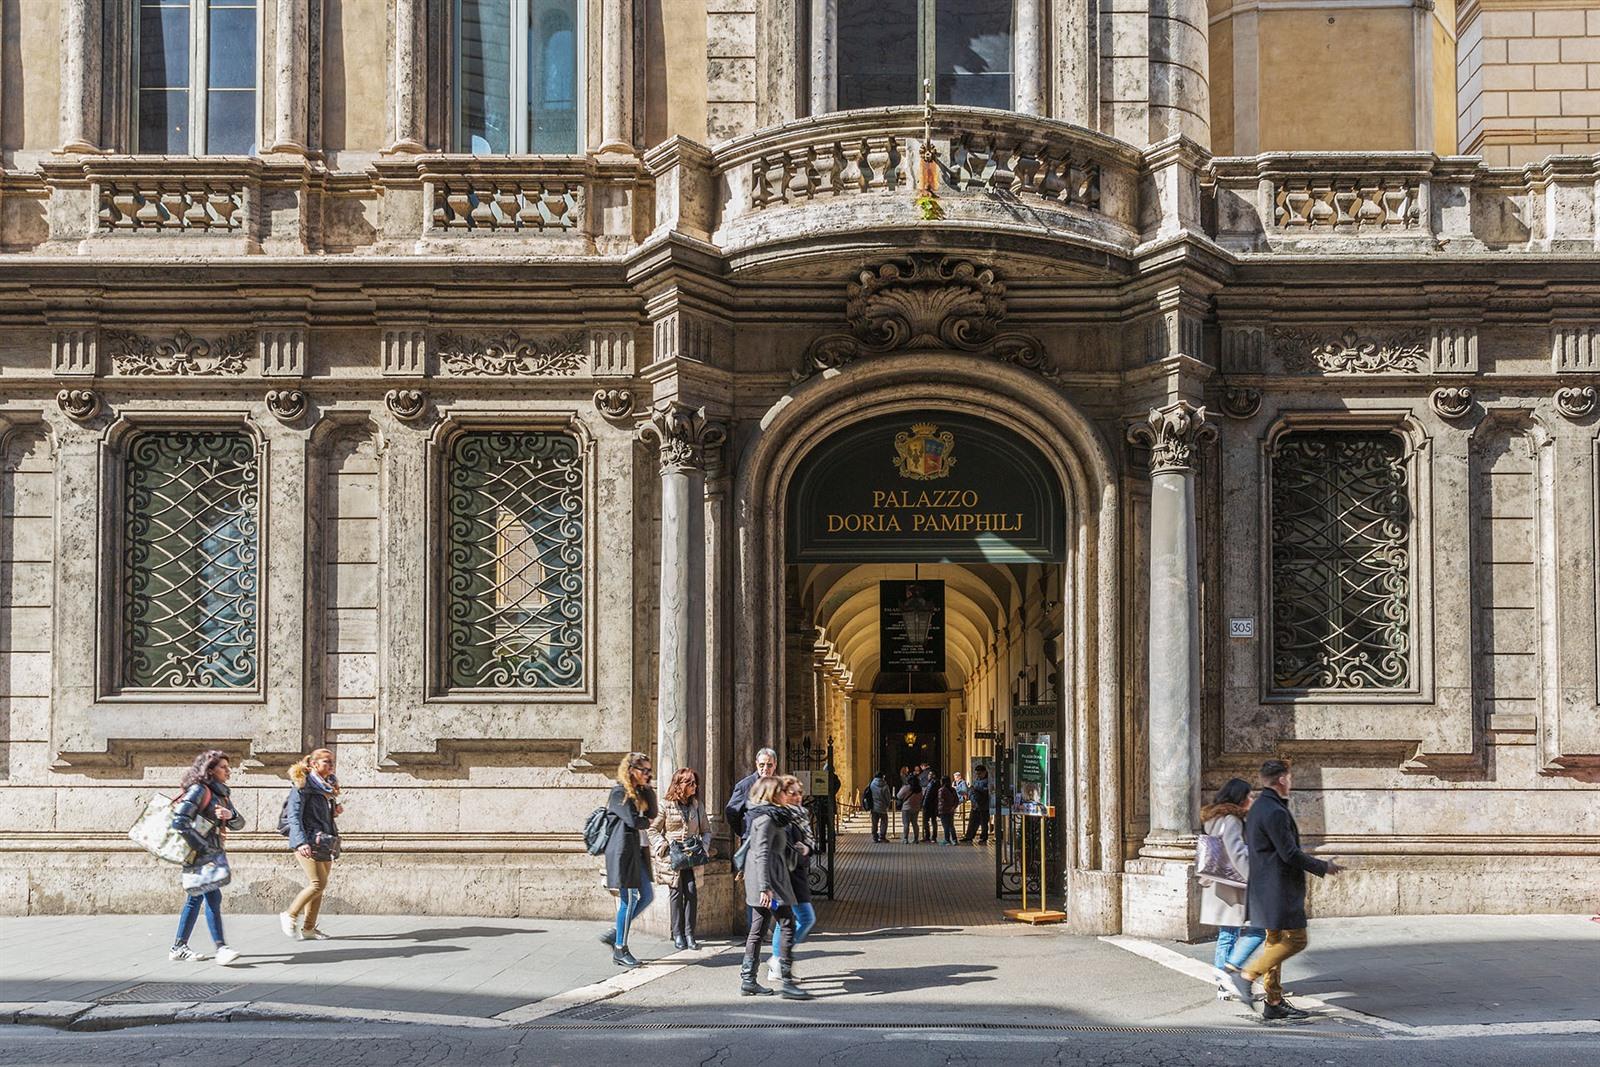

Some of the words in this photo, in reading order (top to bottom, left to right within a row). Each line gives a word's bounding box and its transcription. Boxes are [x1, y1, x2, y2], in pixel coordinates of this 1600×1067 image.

[873, 490, 978, 508] PALAZZO
[827, 514, 902, 532] DORIA
[912, 513, 1023, 532] PAMPHILJ
[1232, 622, 1251, 632] 305
[1013, 706, 1057, 717] BOOKSHOP
[1015, 719, 1055, 730] GIFTSHOP
